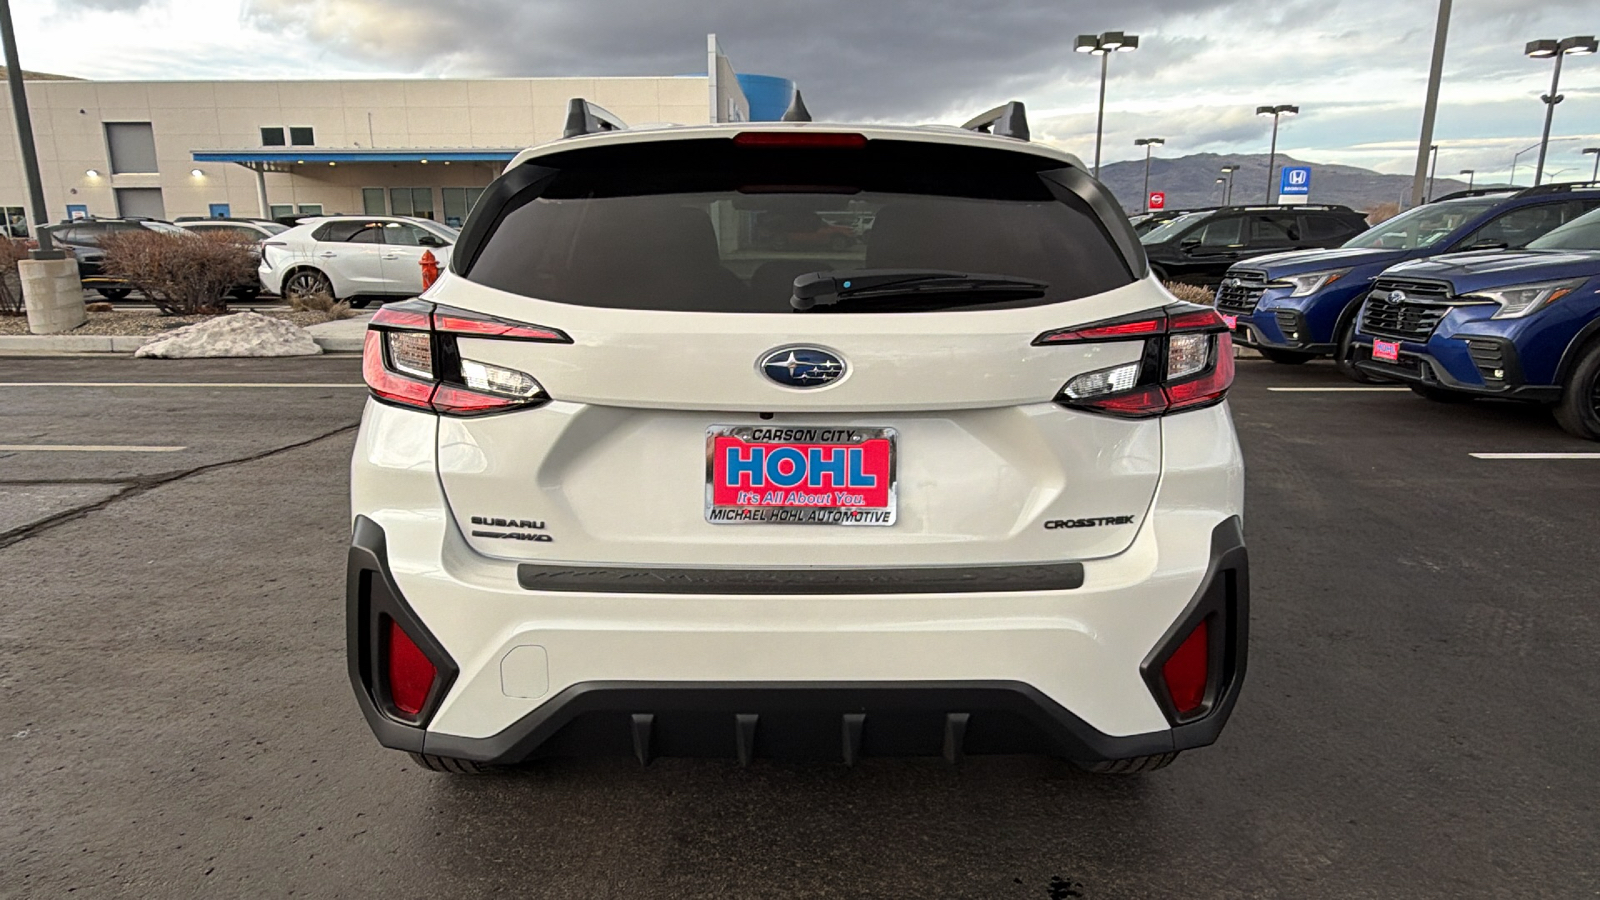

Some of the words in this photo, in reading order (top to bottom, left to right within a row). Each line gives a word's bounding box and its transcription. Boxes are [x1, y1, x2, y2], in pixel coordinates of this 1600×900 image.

[752, 429, 817, 441] CARSON
[821, 430, 856, 442] CITY
[726, 447, 877, 487] HOHL
[737, 491, 760, 505] It's
[763, 491, 783, 505] All
[786, 491, 831, 505] About
[834, 492, 865, 505] You.
[709, 509, 766, 521] MICHAEL
[770, 510, 804, 521] HOHL
[808, 510, 891, 522] AUTOMOTIVE
[1044, 515, 1135, 529] CROSSTREK
[471, 516, 546, 529] SUBARU
[502, 532, 553, 542] AWD
